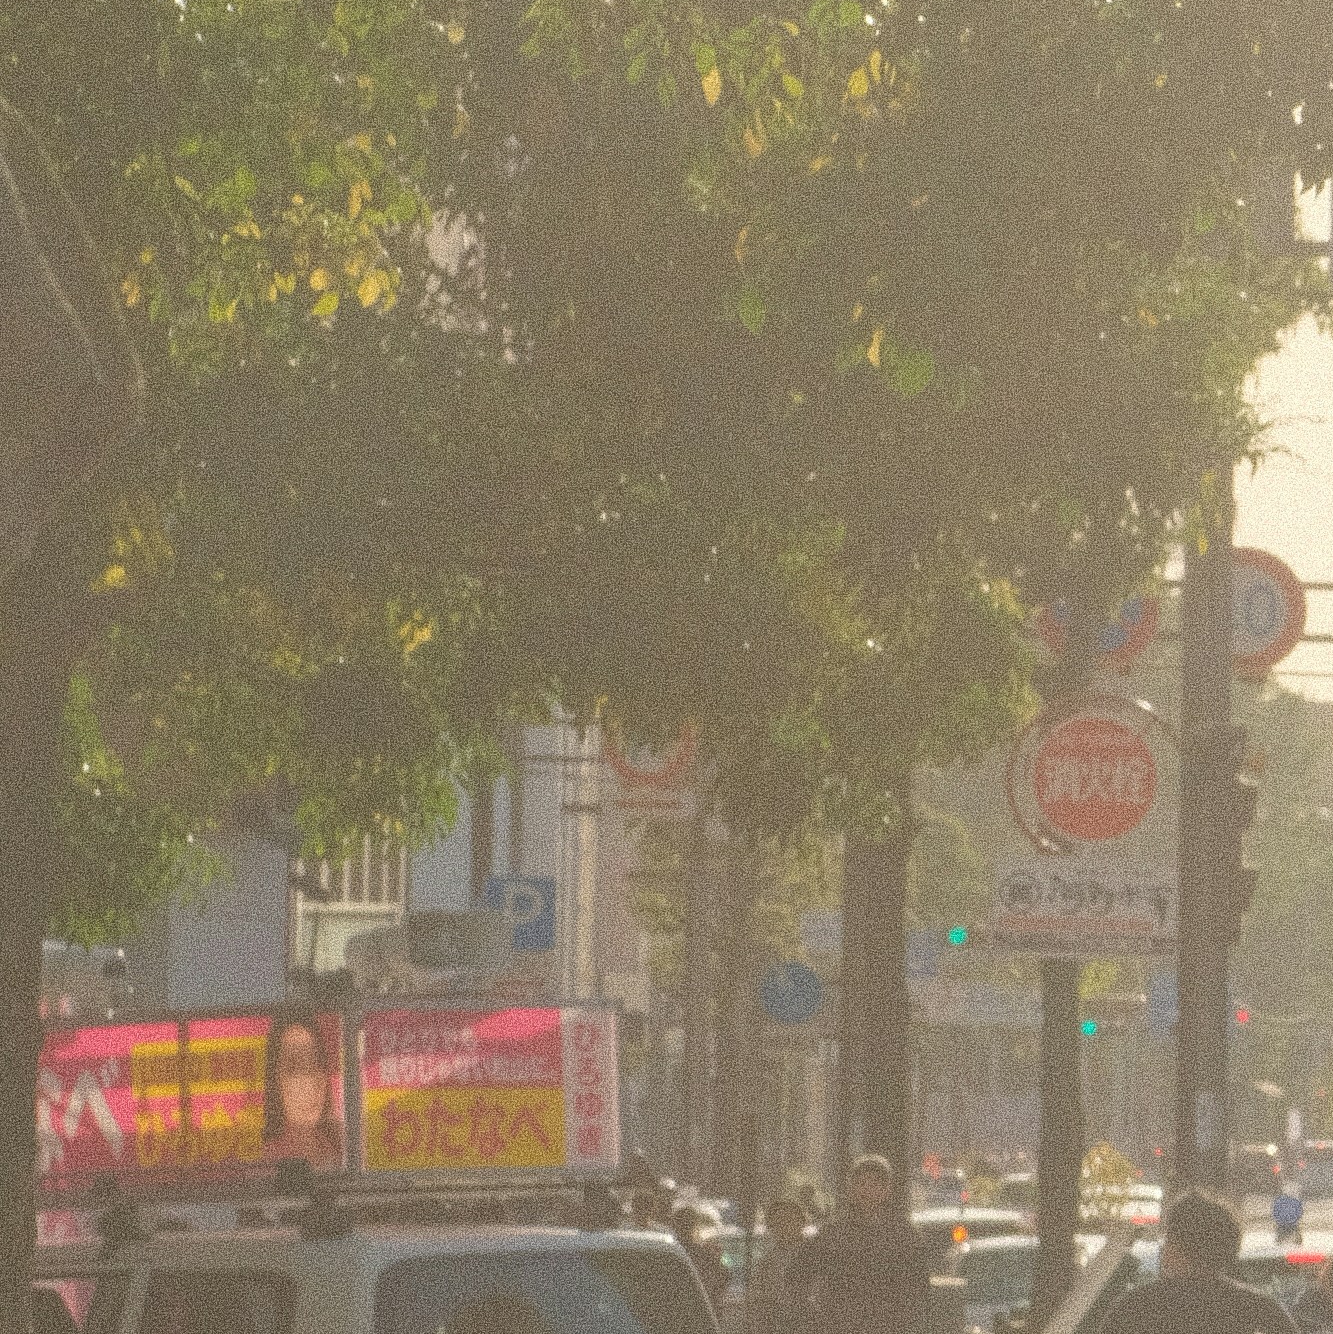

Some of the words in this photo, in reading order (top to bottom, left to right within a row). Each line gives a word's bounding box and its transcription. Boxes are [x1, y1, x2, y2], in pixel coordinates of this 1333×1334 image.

[1043, 756, 1149, 805] 消火栓
[381, 1094, 553, 1161] わたなべ
